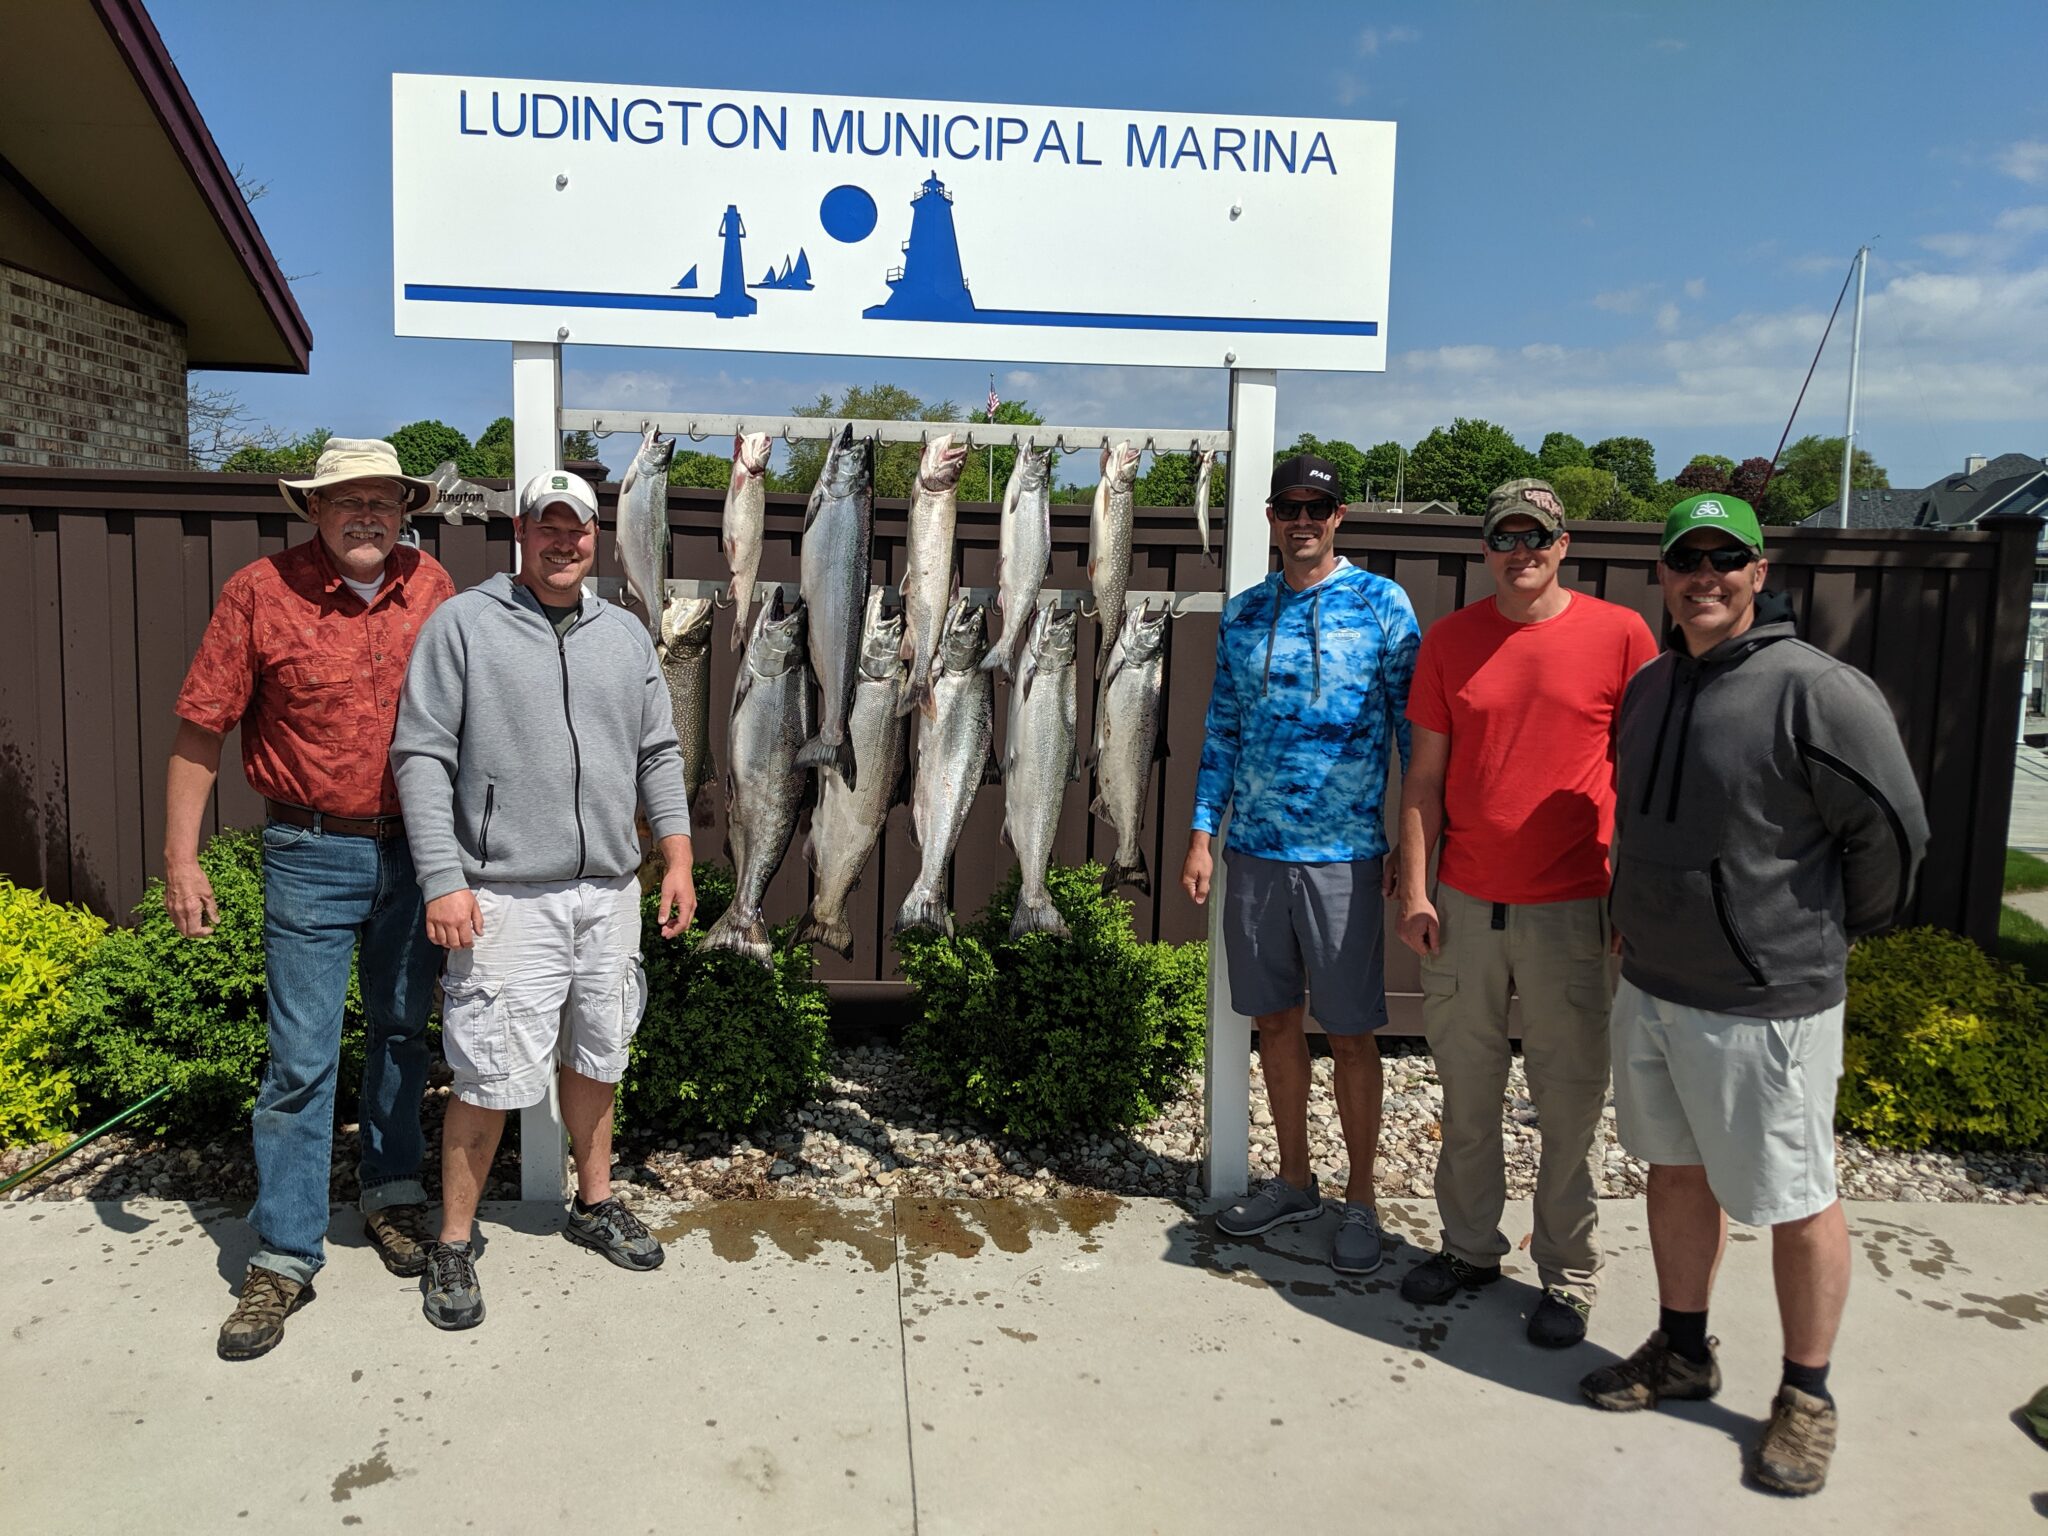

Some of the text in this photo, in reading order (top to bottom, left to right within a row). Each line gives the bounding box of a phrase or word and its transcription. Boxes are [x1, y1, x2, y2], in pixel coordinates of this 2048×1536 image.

[460, 91, 1338, 176] LUDINGTON MUNICIPAL MARINA
[551, 475, 569, 491] S
[1309, 469, 1332, 481] PAG
